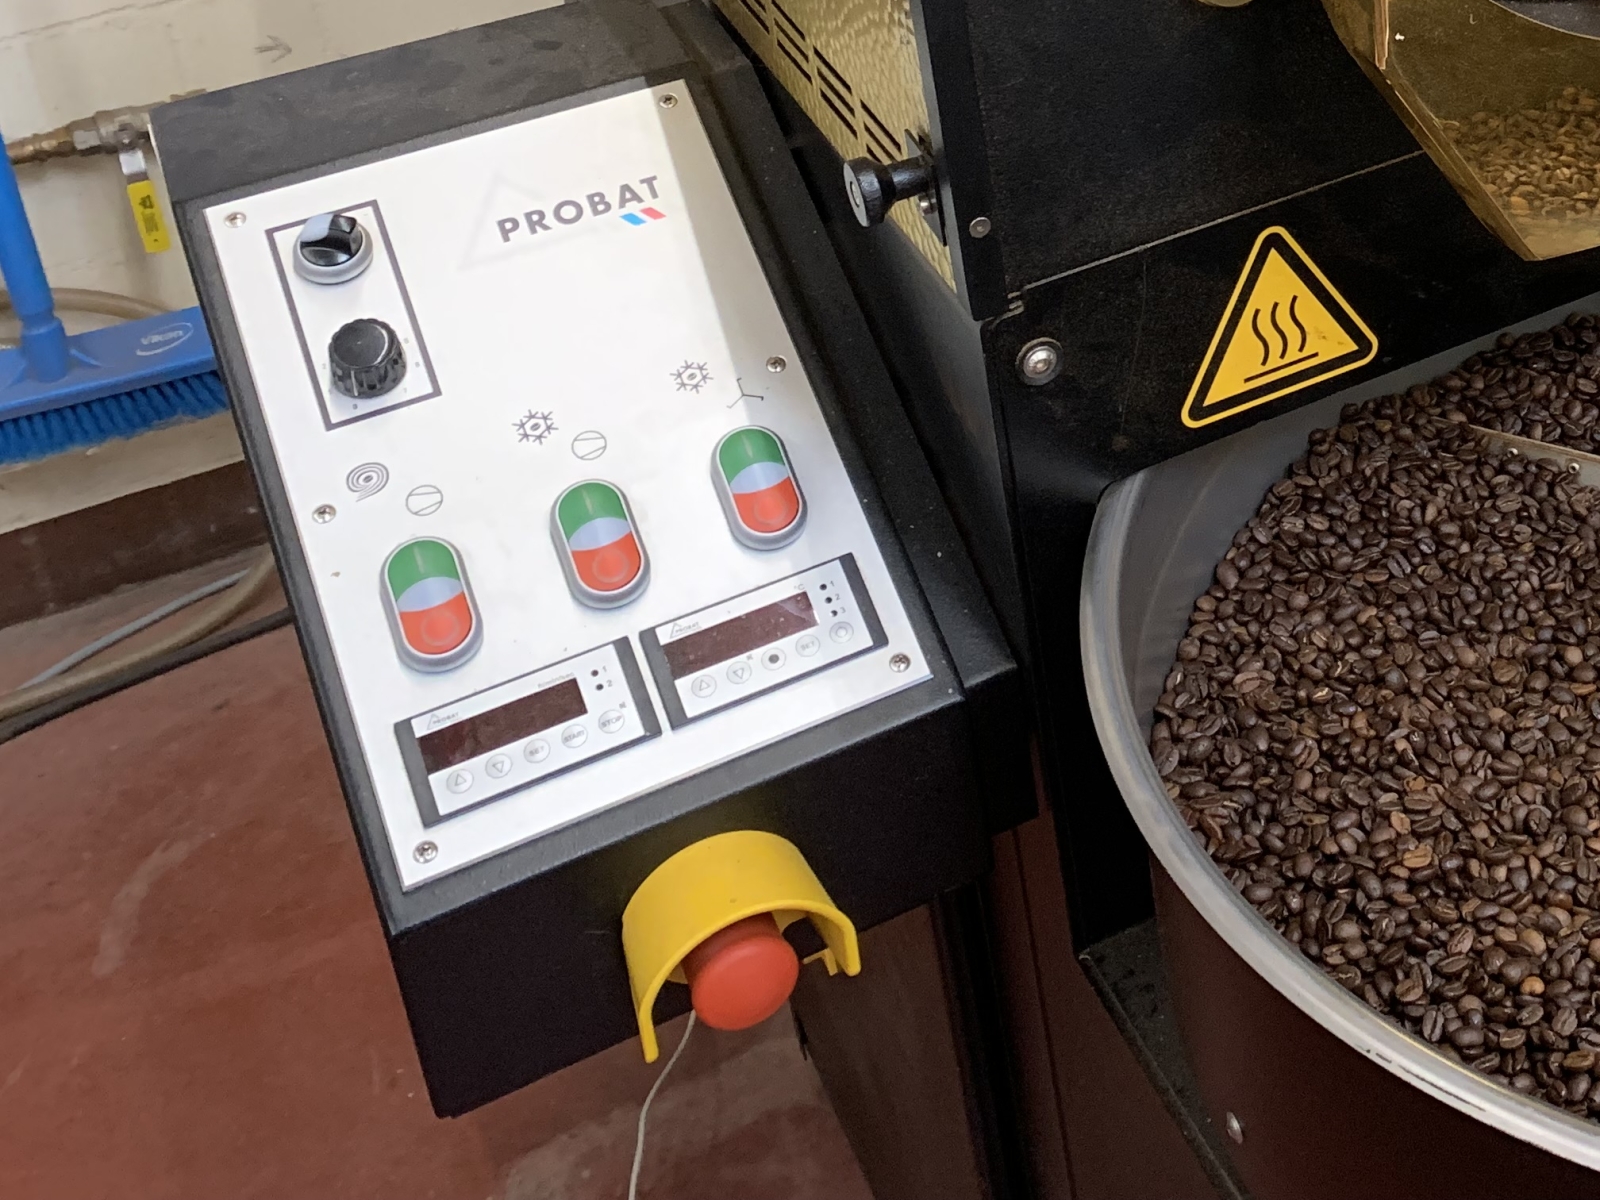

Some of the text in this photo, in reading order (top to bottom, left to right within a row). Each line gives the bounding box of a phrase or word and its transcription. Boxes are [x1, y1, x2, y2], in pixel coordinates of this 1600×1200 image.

[496, 175, 660, 243] PROBAT
[800, 640, 815, 652] SET
[600, 715, 623, 729] STOP
[563, 729, 586, 743] START
[528, 745, 546, 757] SET
